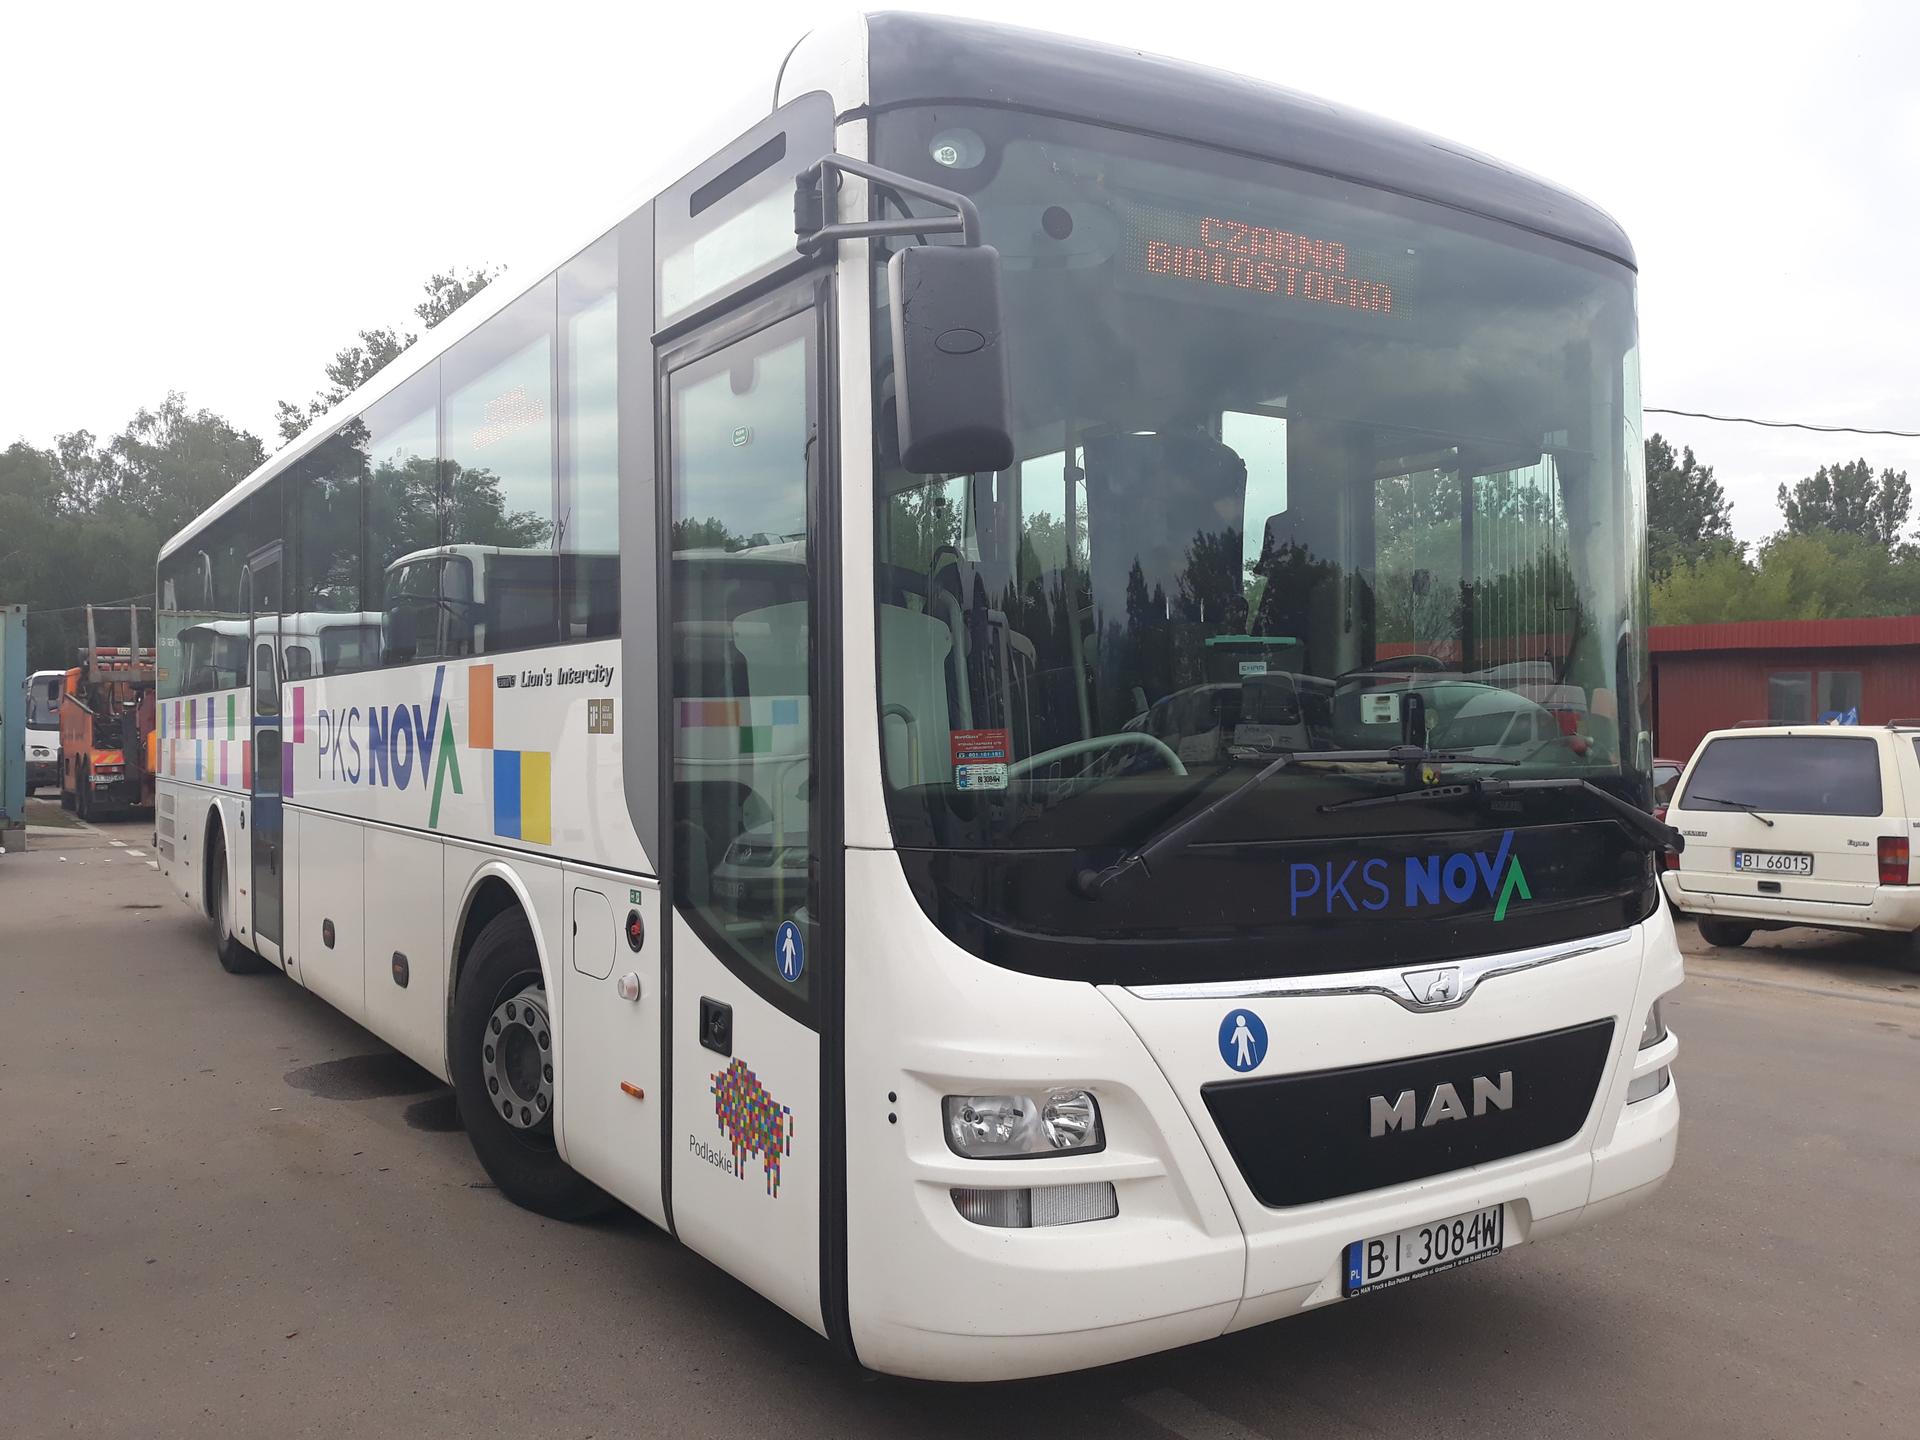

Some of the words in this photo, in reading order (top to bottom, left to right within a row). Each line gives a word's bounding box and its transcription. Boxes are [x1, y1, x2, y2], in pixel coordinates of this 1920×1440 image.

[1201, 216, 1345, 272] CZARNA
[1148, 239, 1392, 313] BIAŁOSTOCKA
[520, 667, 553, 688] Lion's
[557, 663, 615, 688] Intercity
[318, 706, 361, 785] PKS
[368, 664, 464, 829] NOVA
[1290, 858, 1390, 916] PKS
[1405, 830, 1533, 921] NOVA
[1743, 854, 1760, 868] BI
[1766, 855, 1809, 871] 66015
[1370, 1071, 1513, 1138] MAN
[689, 1134, 733, 1174] Podlaskie
[1367, 1234, 1401, 1280] BI
[1418, 1209, 1497, 1265] 3084W
[1350, 1270, 1361, 1281] PL
[1360, 1286, 1371, 1295] MAN
[1372, 1282, 1384, 1290] Truck
